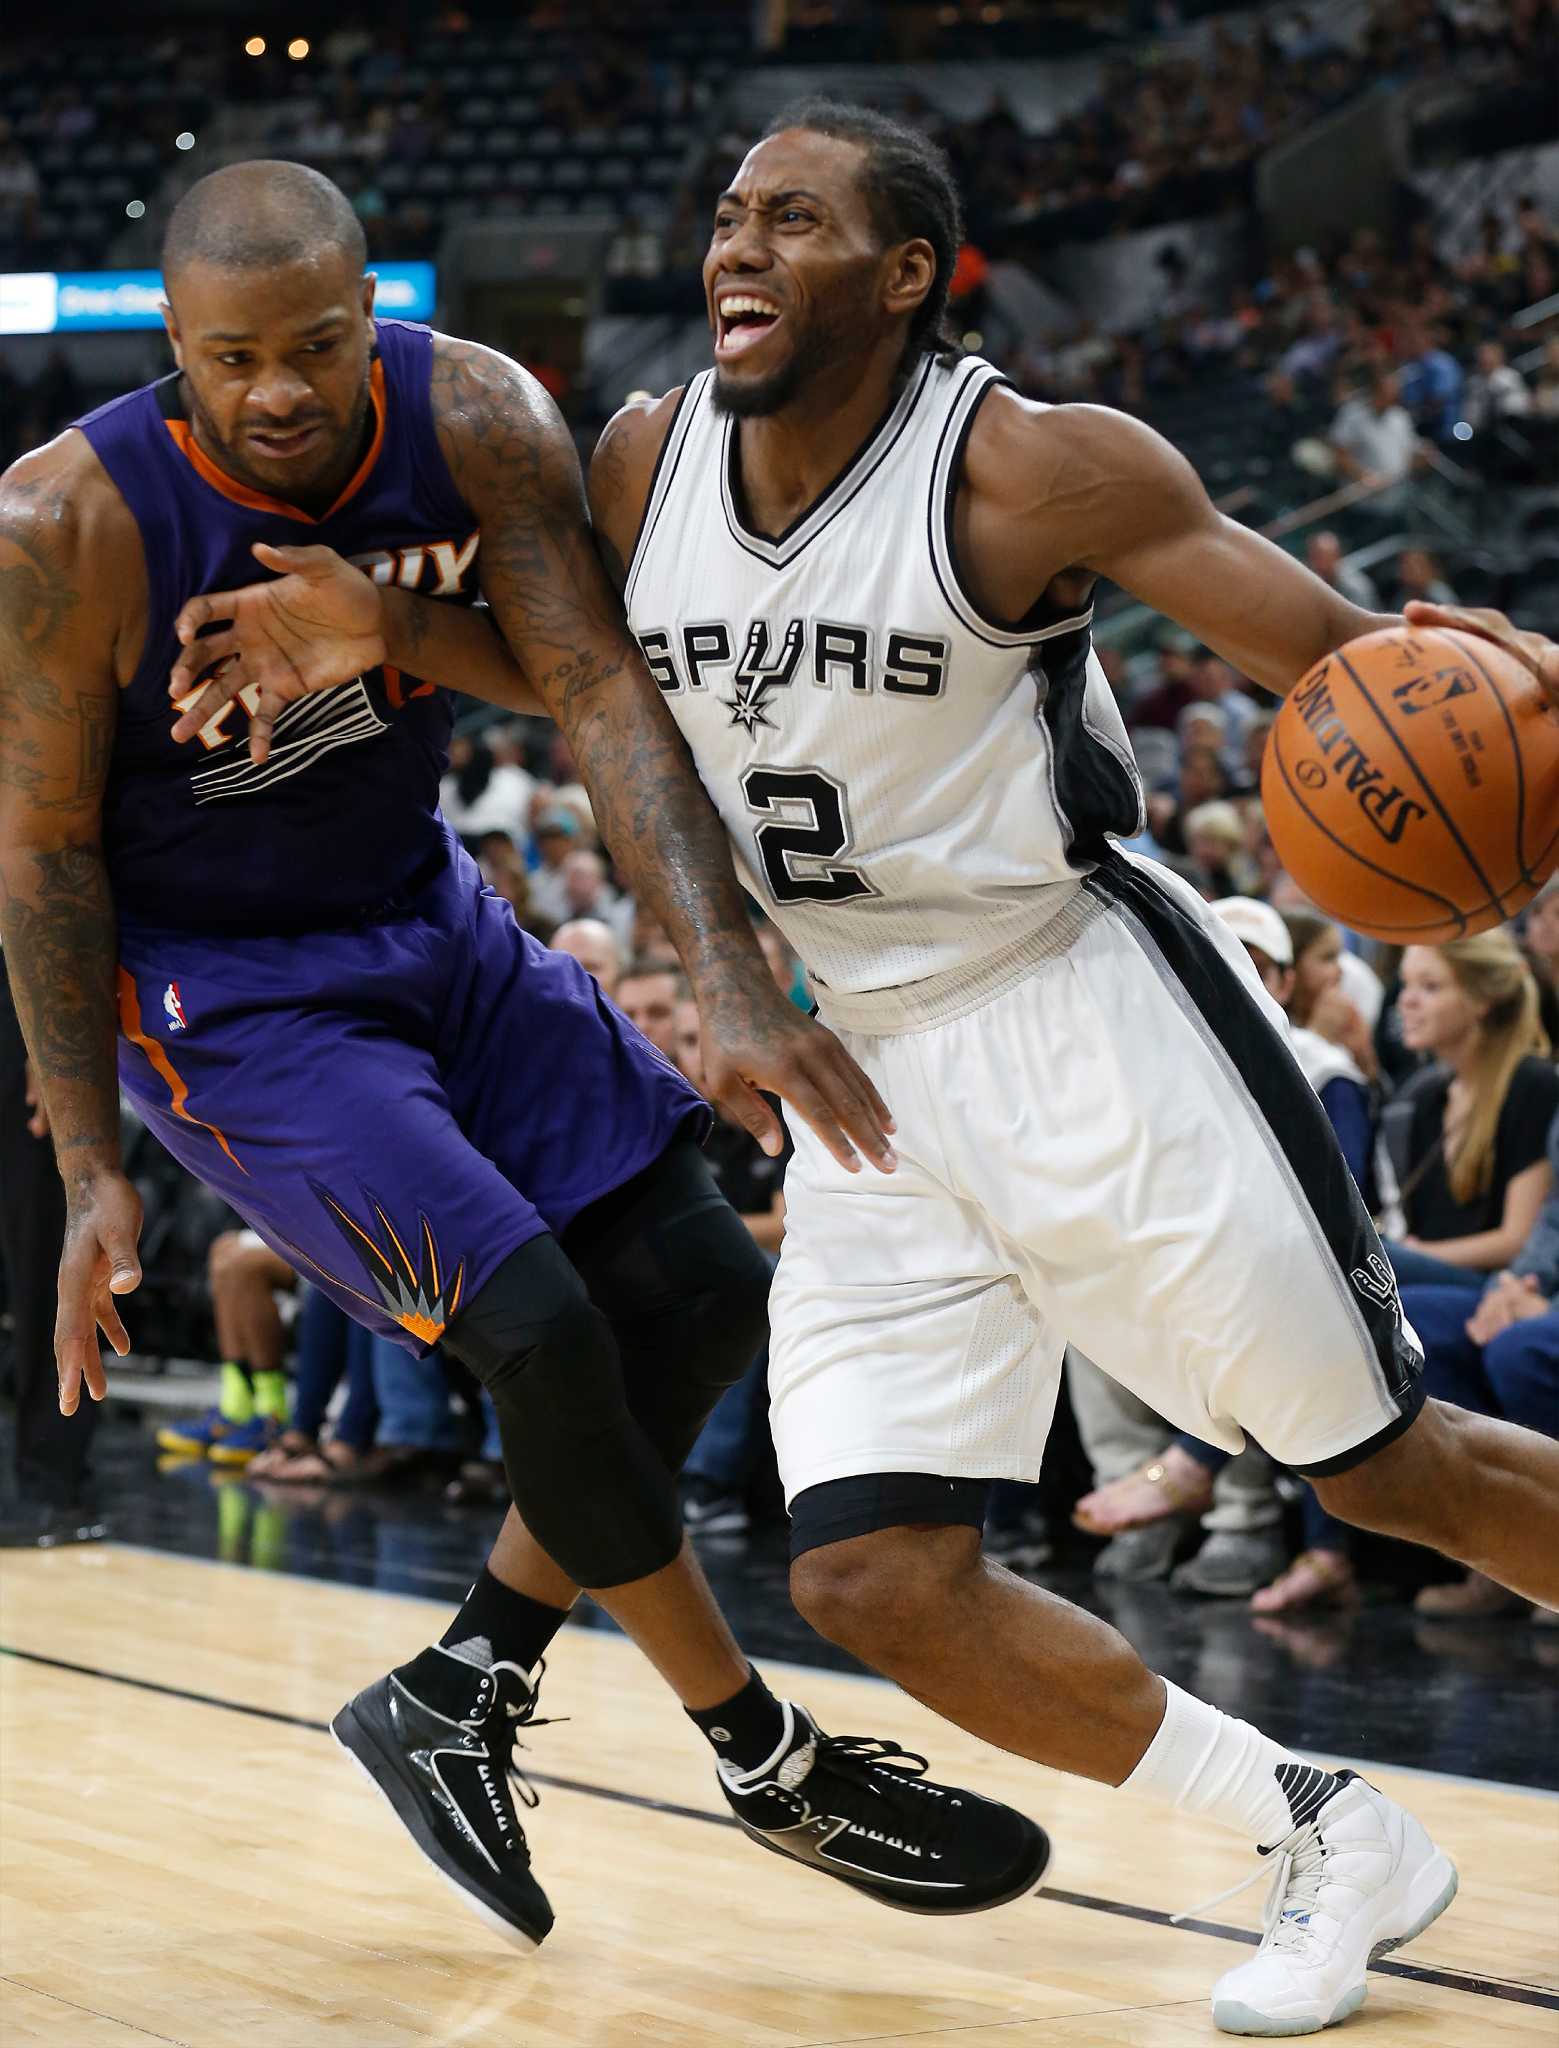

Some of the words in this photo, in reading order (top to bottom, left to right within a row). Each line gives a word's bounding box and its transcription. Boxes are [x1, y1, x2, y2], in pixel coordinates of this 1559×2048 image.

[637, 617, 951, 699] SPURS
[1293, 661, 1427, 844] SPALDING
[738, 763, 884, 906] 2
